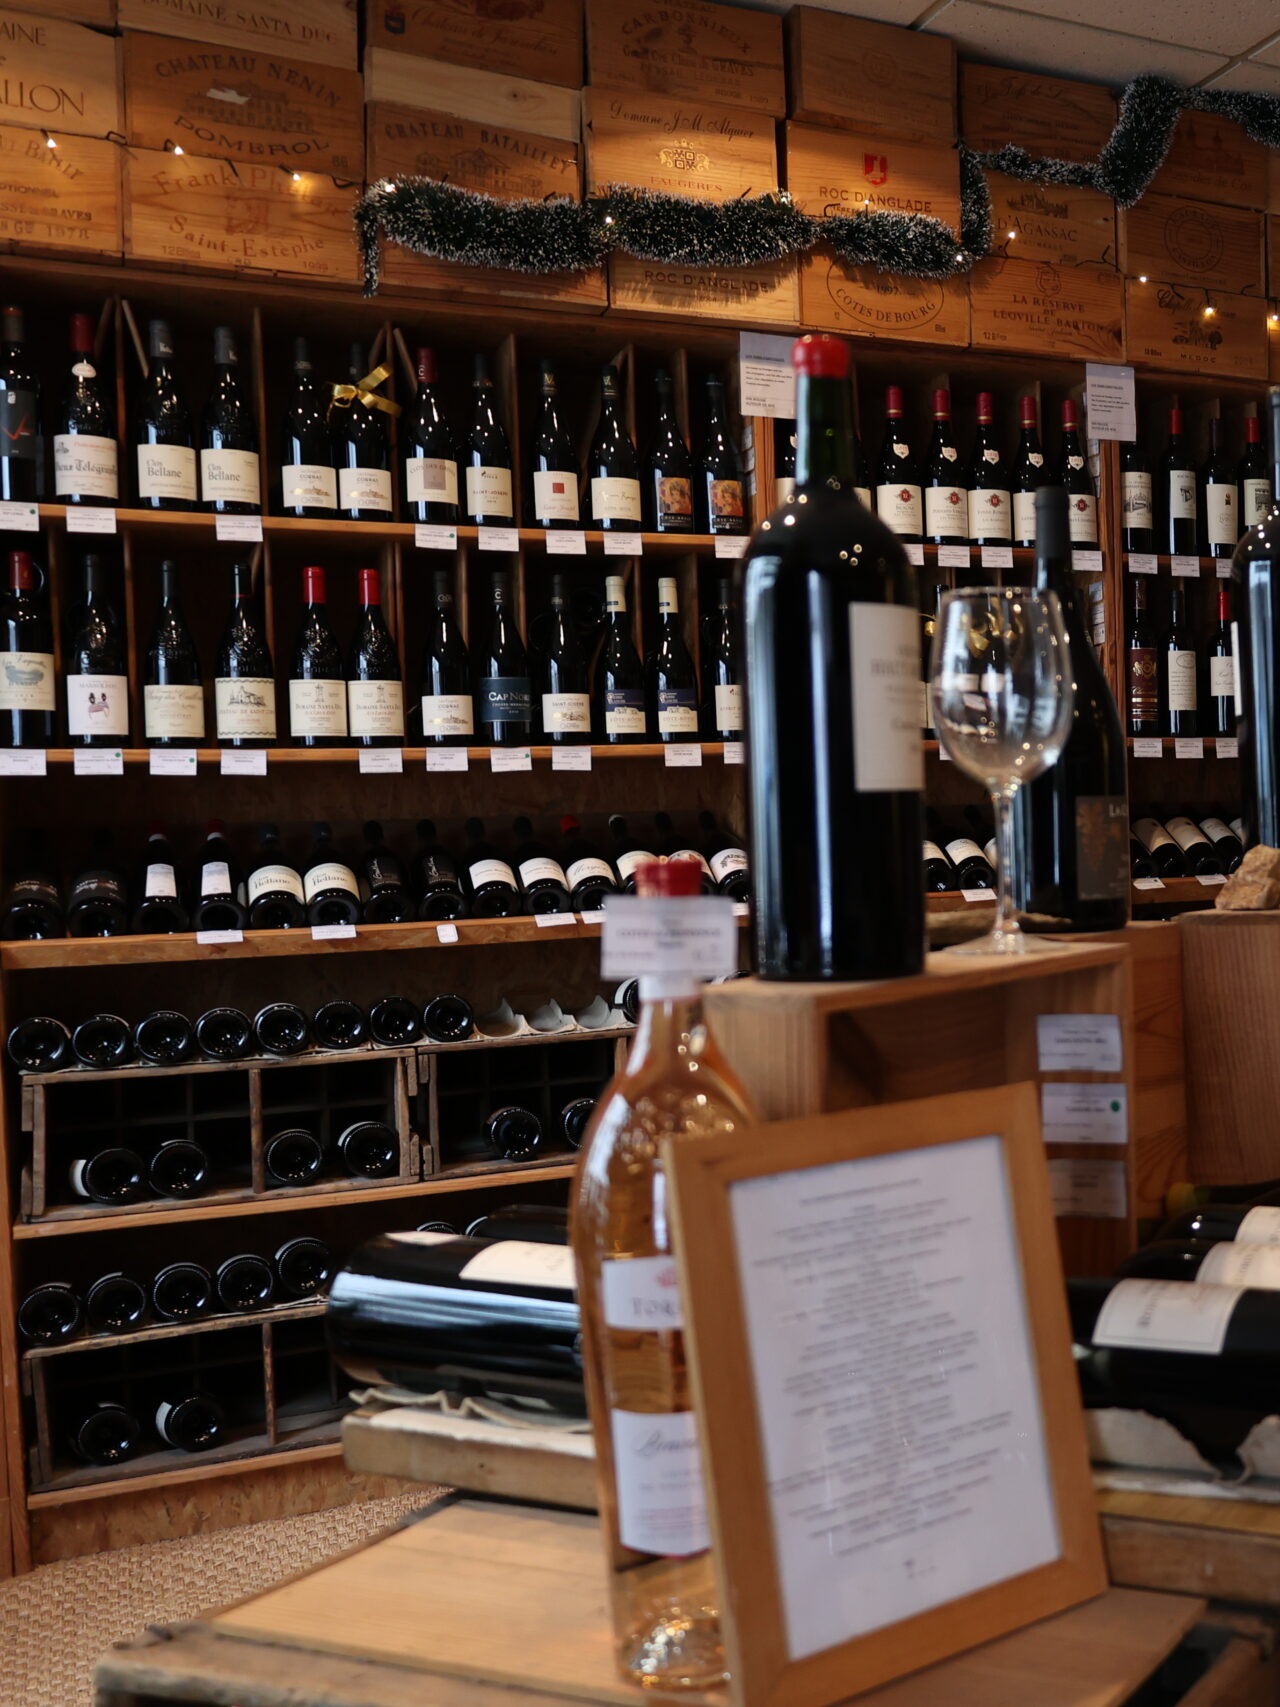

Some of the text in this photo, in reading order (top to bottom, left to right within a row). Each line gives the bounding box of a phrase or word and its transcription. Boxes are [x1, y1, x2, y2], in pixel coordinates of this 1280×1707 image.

[236, 13, 291, 36] SANTA
[155, 53, 343, 108] CHATEAU NENIN
[173, 115, 331, 157] POMEROL
[152, 165, 239, 196] Frank
[819, 186, 933, 214] ROC D'ANGLADE
[644, 270, 677, 284] ROC
[876, 311, 891, 323] DE
[895, 300, 937, 323] BOURG
[147, 466, 182, 479] Bellane
[208, 471, 241, 482] Bellane
